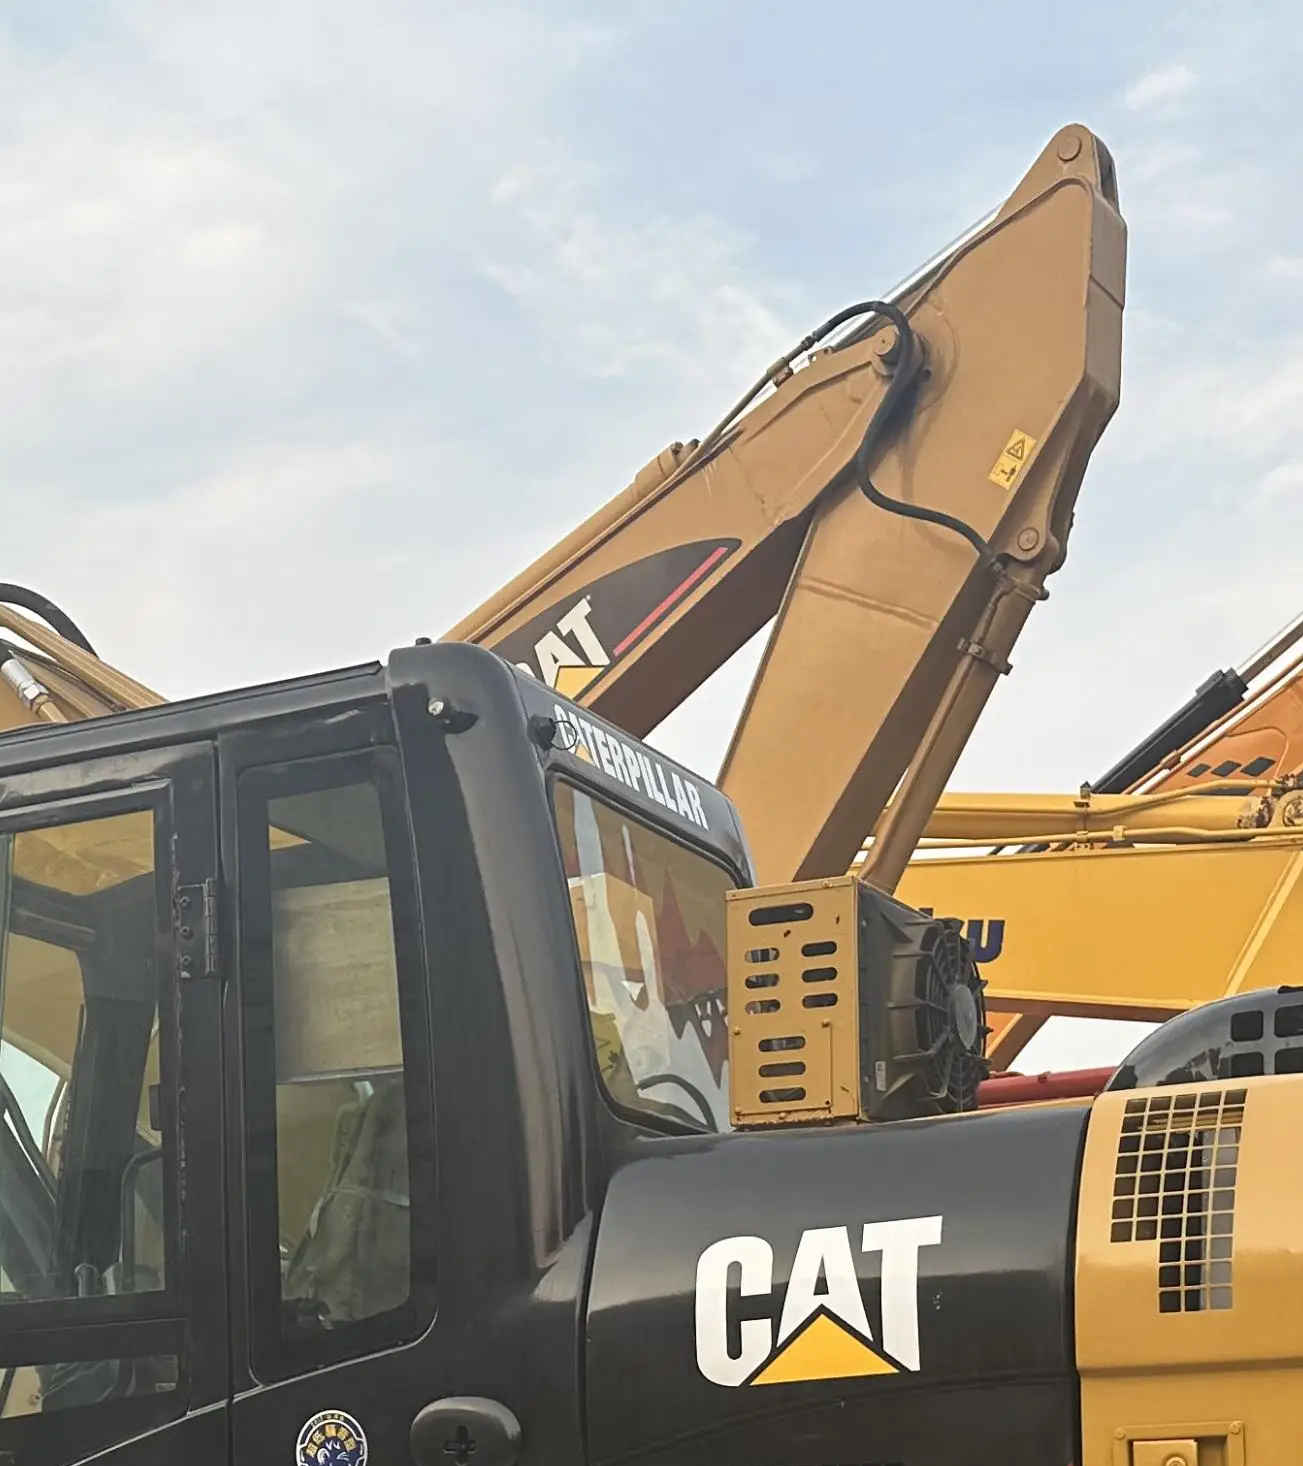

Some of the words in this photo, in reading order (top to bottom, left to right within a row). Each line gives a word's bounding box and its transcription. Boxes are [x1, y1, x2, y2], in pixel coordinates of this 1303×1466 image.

[516, 598, 610, 687] AT
[554, 704, 709, 829] CATERPILLAR
[695, 1216, 942, 1387] CAT
